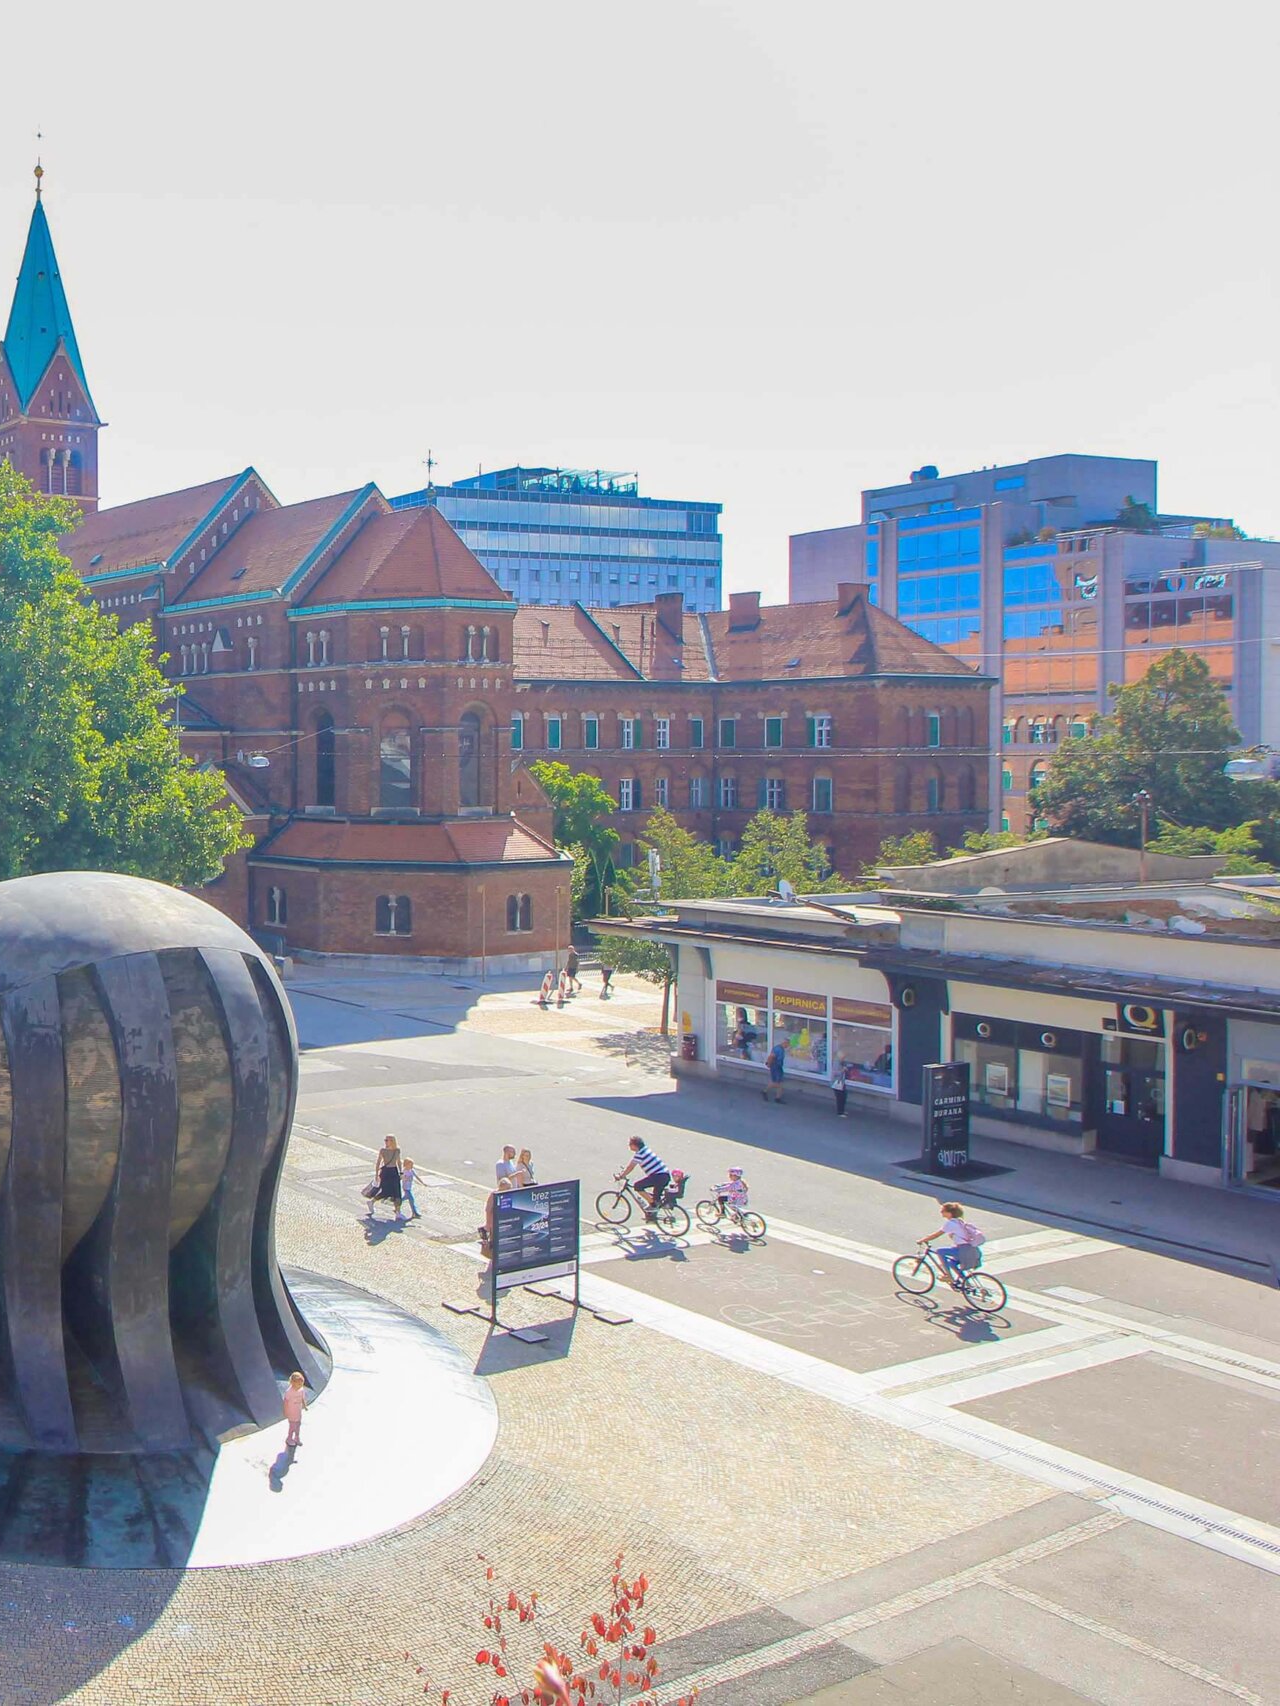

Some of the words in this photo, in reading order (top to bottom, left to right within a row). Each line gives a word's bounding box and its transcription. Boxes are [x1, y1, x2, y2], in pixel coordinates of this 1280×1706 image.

[773, 994, 826, 1011] PAPIRNICA
[1123, 1004, 1158, 1029] Q
[934, 1095, 966, 1106] CARMINA
[933, 1107, 963, 1118] BURANA
[531, 1191, 550, 1202] brez
[531, 1221, 549, 1231] 23/24
